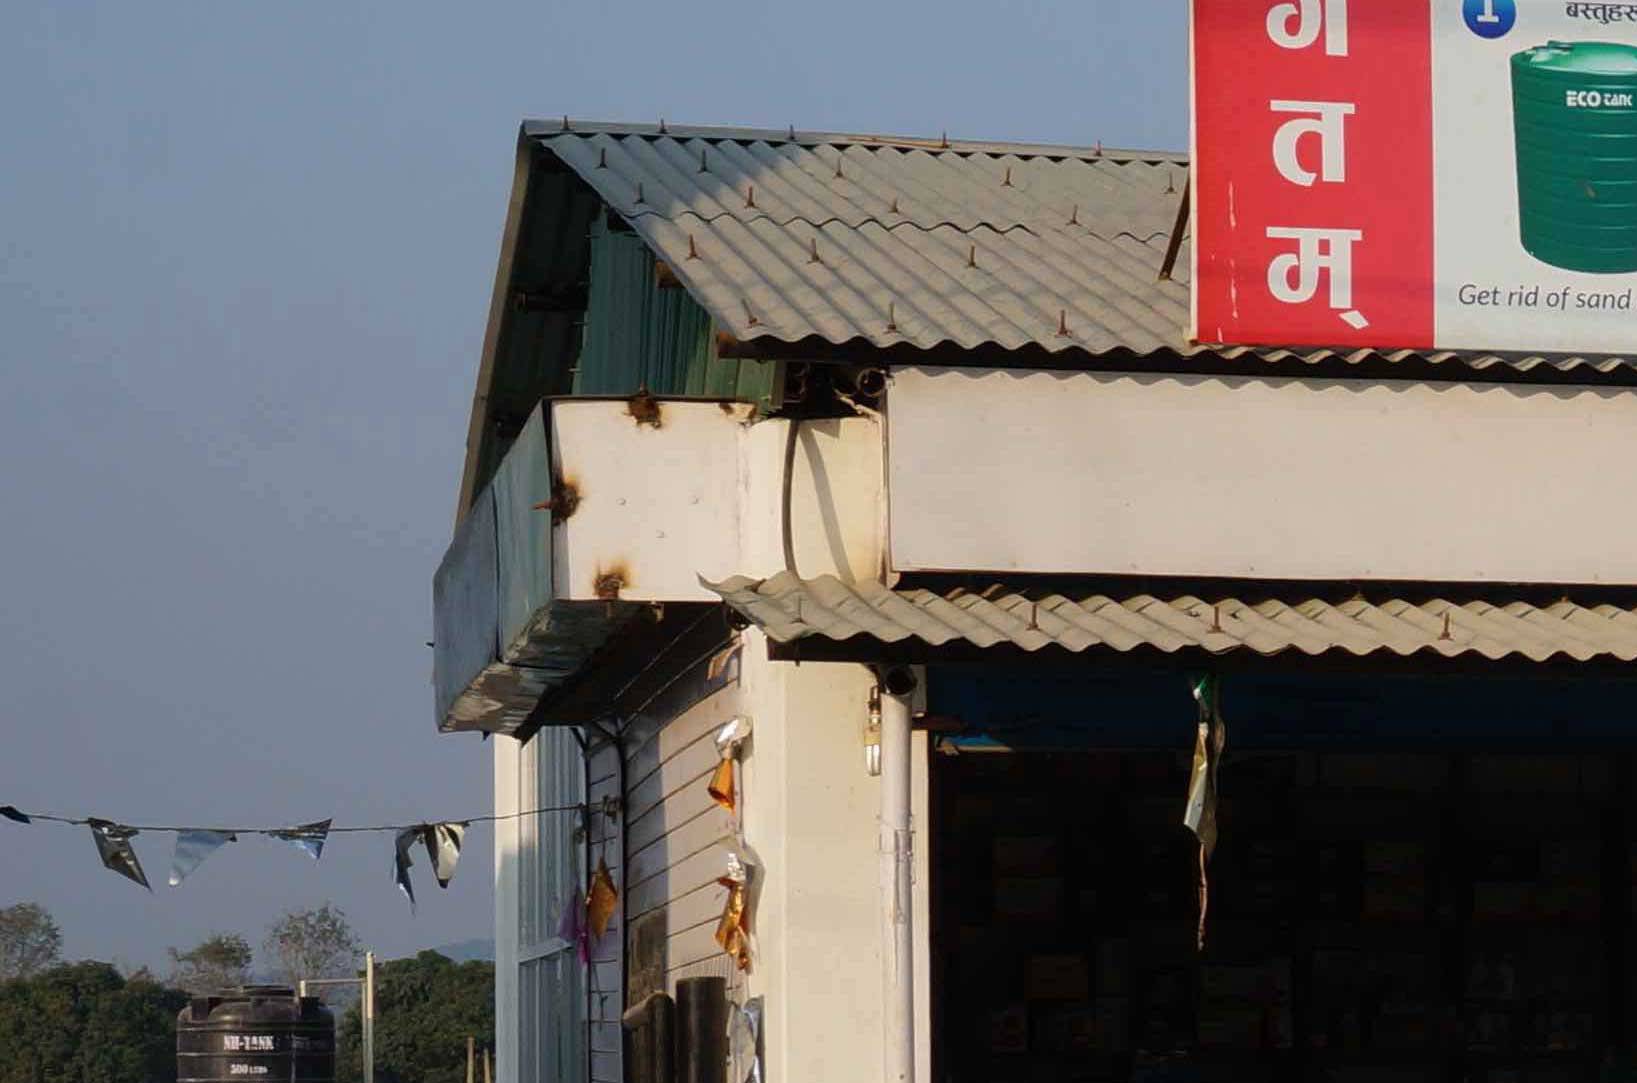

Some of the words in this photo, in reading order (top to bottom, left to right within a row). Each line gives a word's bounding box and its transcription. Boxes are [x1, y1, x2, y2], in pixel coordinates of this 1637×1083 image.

[1567, 91, 1601, 106] ECO
[1459, 284, 1500, 305] Get
[1508, 286, 1539, 306] rid
[1546, 287, 1570, 310] of
[1576, 289, 1631, 310] sand
